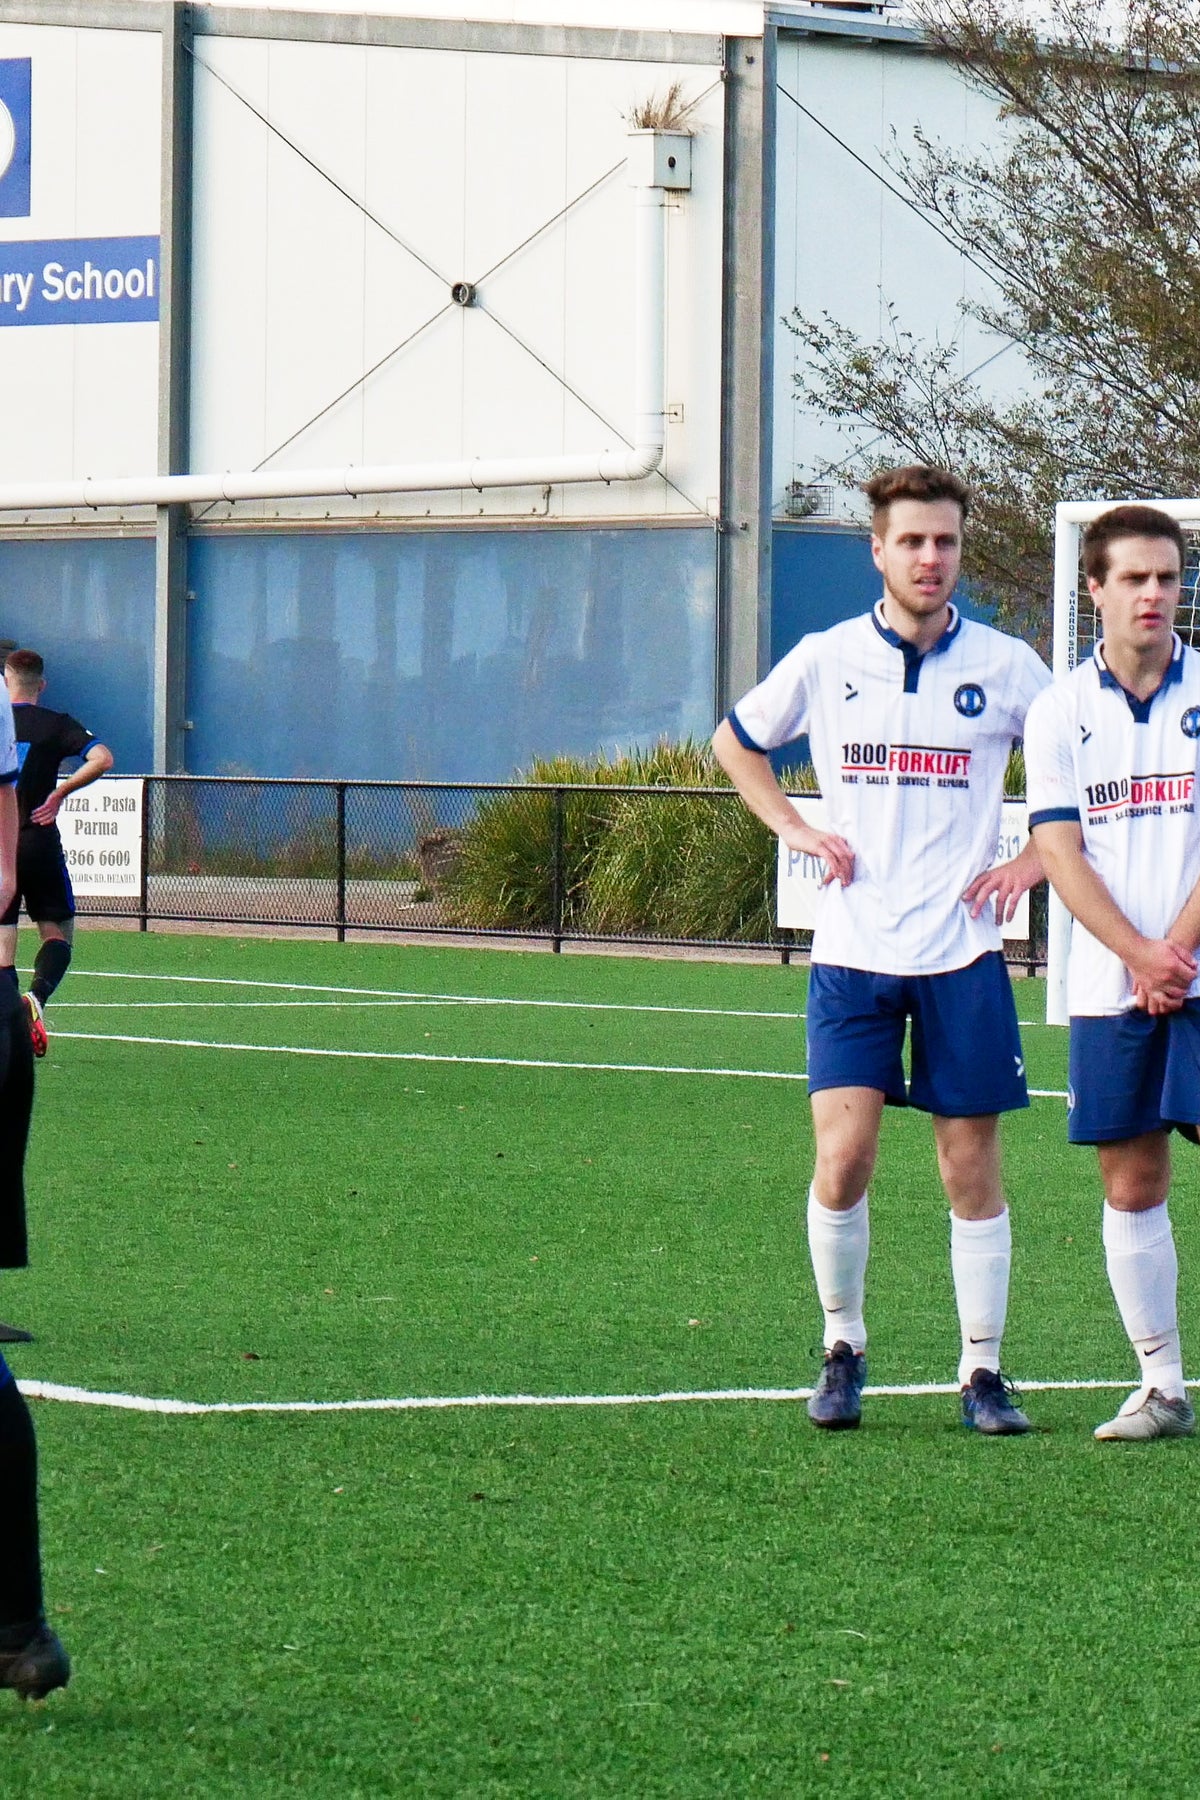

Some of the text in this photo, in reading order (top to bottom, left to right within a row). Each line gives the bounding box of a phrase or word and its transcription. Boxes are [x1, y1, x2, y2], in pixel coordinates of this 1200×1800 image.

[0, 258, 155, 312] ry School
[1067, 640, 1075, 672] SPORT
[842, 743, 971, 776] 1800 FORKLIFT
[866, 775, 889, 785] SALES
[897, 775, 930, 787] SERVICE
[937, 778, 969, 789] REPAIRS
[1085, 778, 1129, 806] 1800
[64, 796, 136, 812] izza Pasta
[74, 818, 118, 836] Parma
[99, 849, 130, 867] 6600
